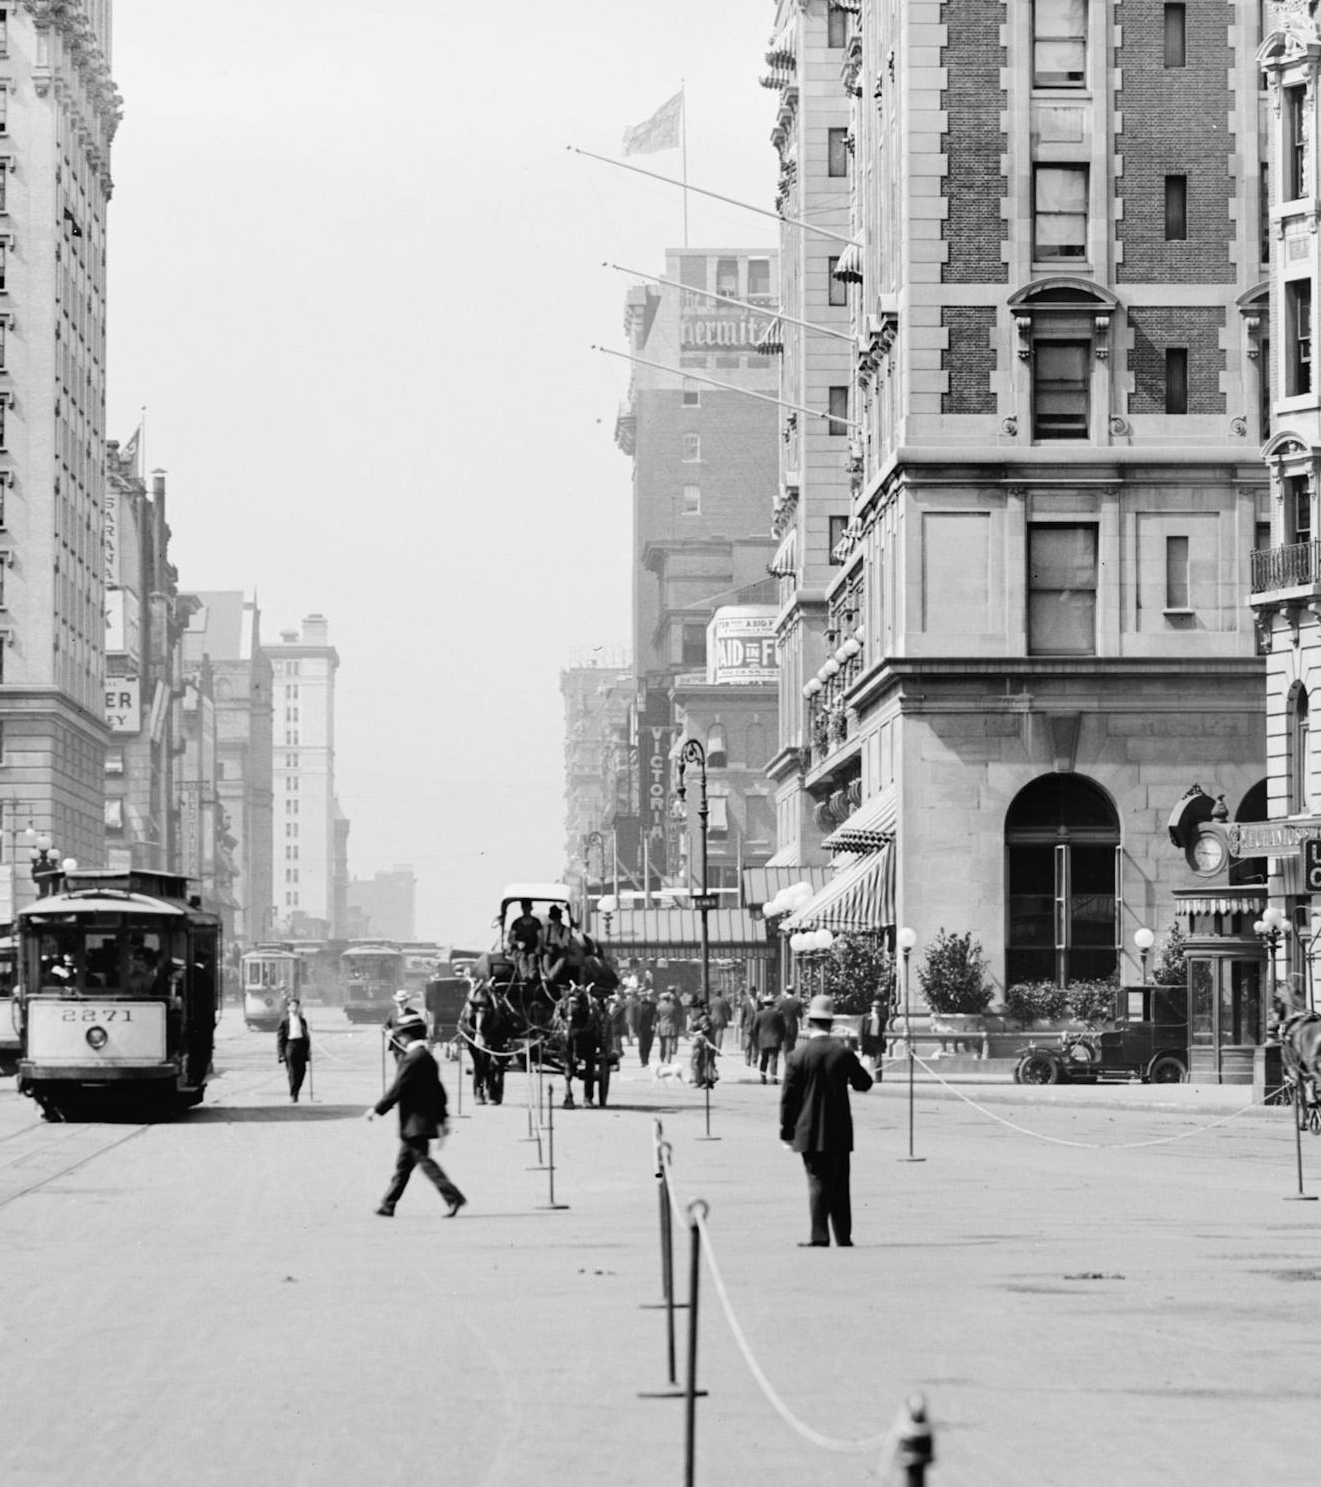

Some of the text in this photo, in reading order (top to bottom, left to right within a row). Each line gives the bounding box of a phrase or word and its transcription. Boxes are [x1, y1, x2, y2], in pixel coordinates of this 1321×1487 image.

[717, 638, 745, 668] AID
[104, 691, 133, 709] ER
[649, 726, 665, 839] VICTORIA
[61, 1008, 133, 1023] 2271
